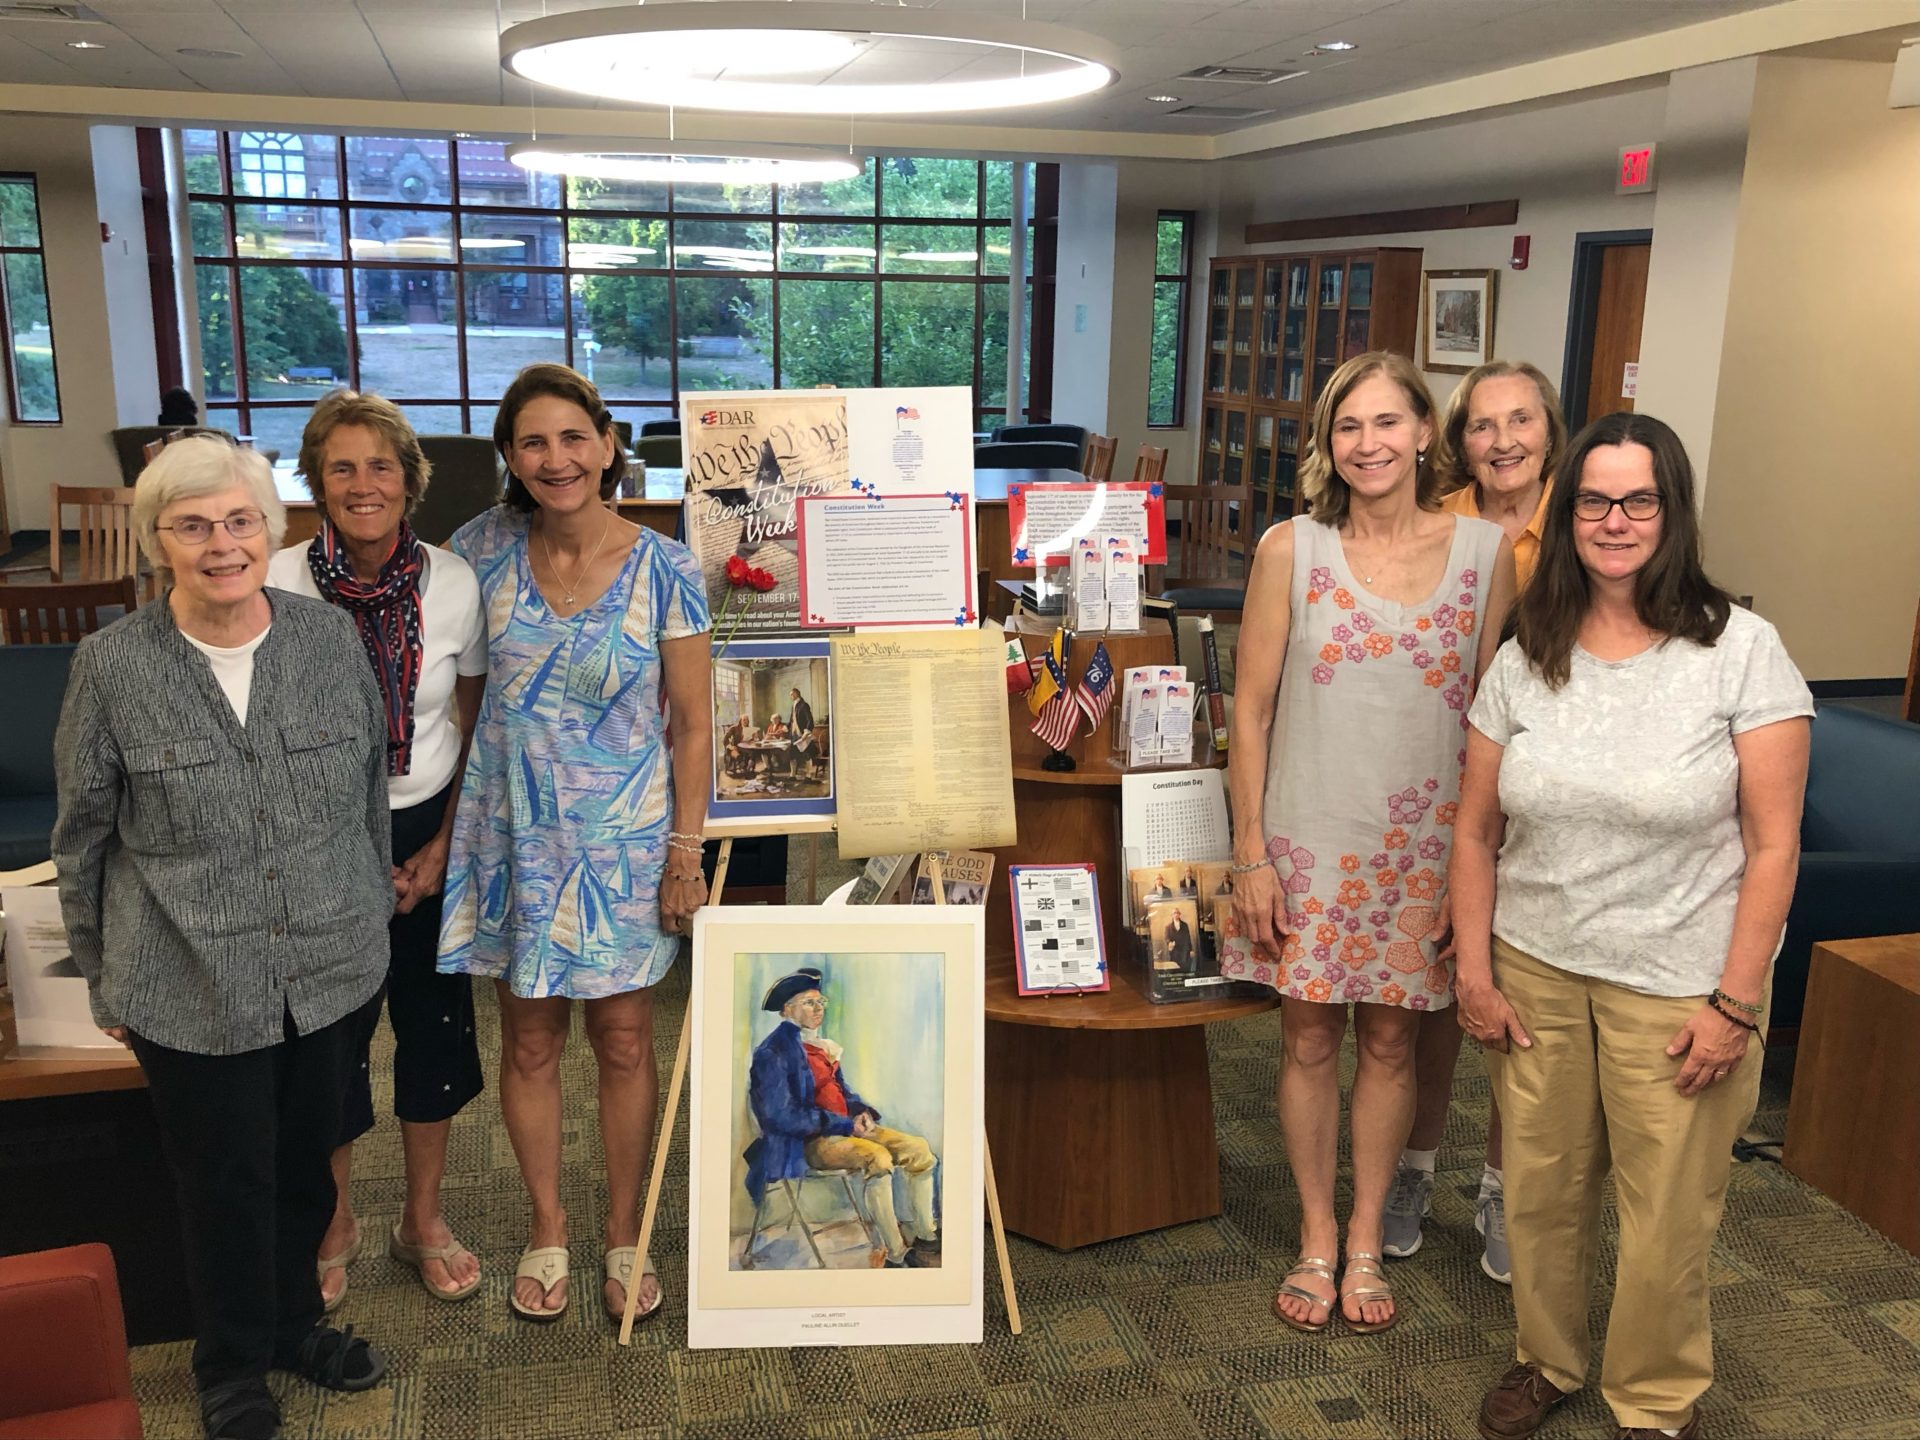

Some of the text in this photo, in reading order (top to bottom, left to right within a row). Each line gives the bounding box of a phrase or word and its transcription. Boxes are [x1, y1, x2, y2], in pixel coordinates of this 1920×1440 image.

[1622, 149, 1651, 187] EXIT
[718, 410, 756, 425] DAR
[706, 469, 837, 525] Constitution
[823, 503, 884, 512] Constitution Week
[744, 503, 798, 544] Week
[788, 593, 800, 603] 17-
[757, 611, 773, 619] about
[773, 612, 785, 620] your
[840, 643, 856, 655] We
[857, 641, 870, 657] the
[871, 641, 901, 657] People
[1087, 663, 1103, 682] 76
[1153, 779, 1203, 790] Constitution Day
[957, 857, 985, 869] ODD
[926, 866, 983, 881] CAUSES
